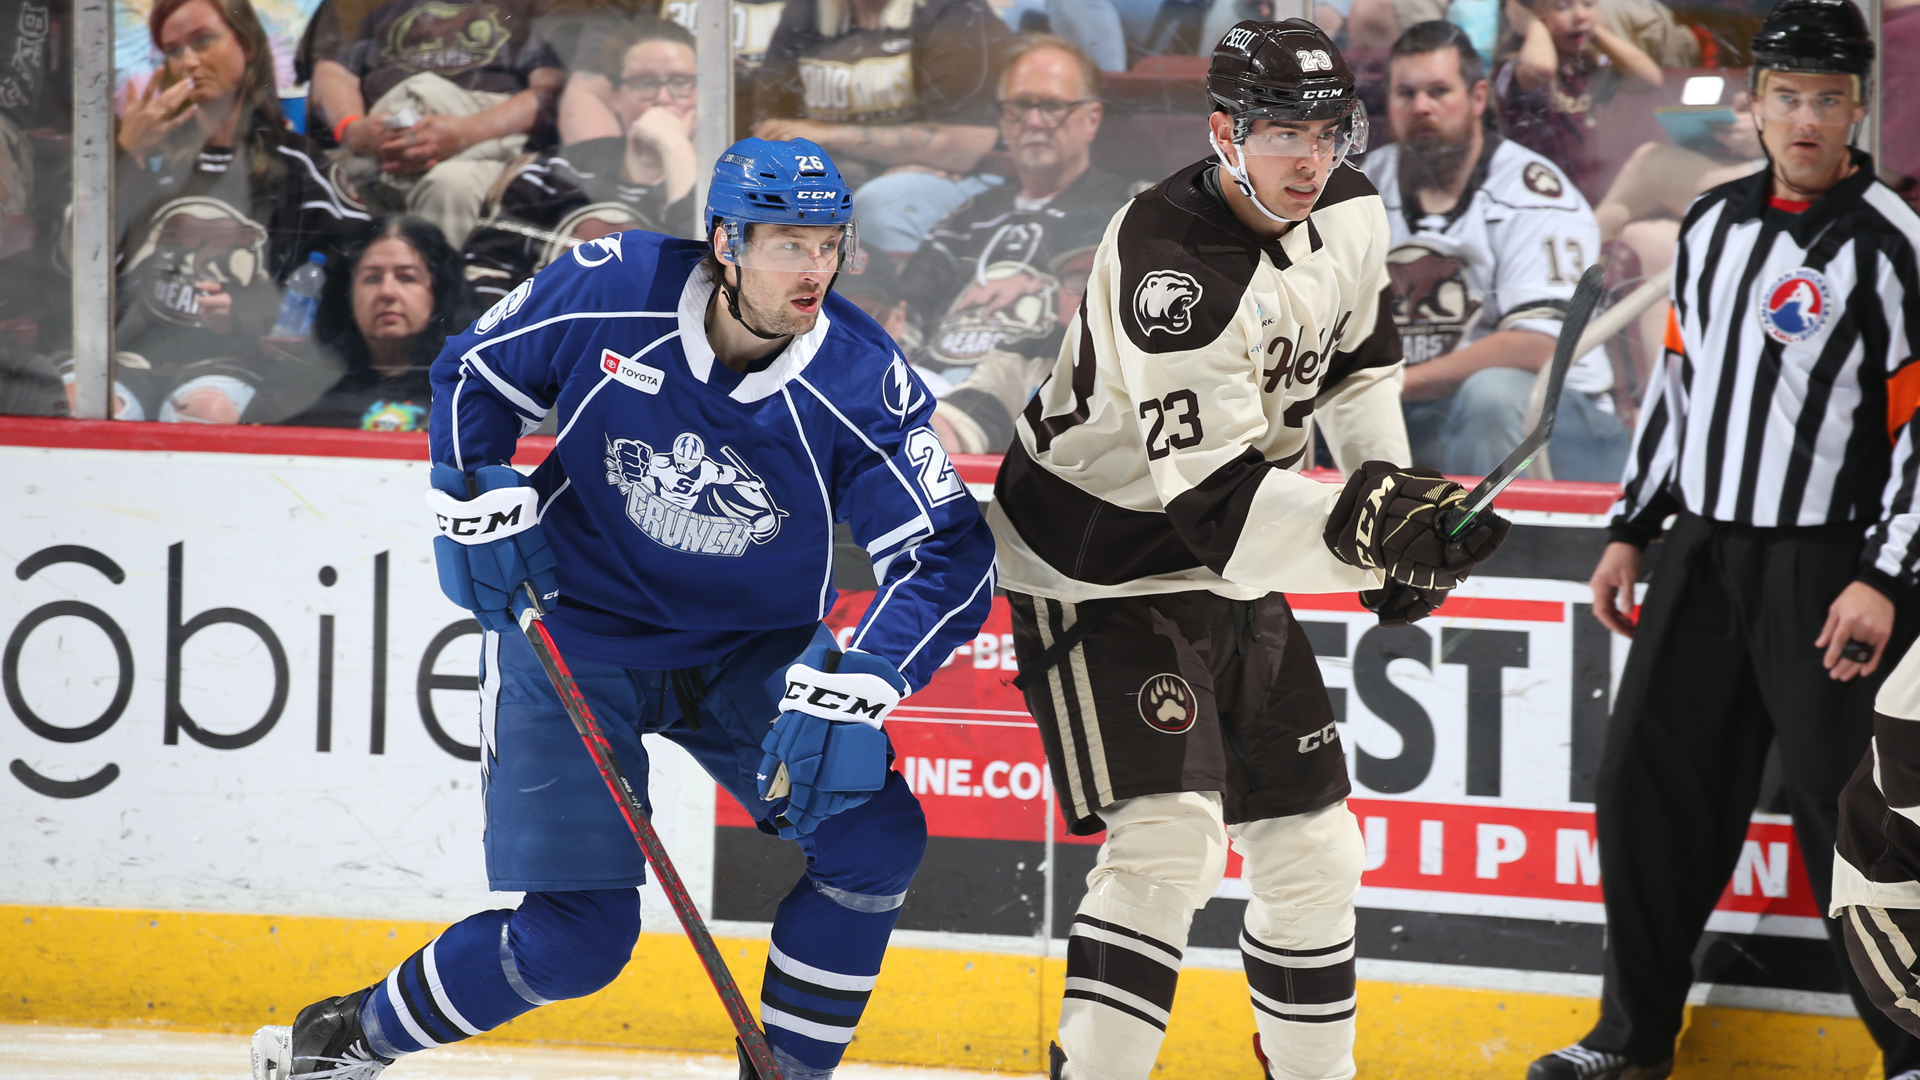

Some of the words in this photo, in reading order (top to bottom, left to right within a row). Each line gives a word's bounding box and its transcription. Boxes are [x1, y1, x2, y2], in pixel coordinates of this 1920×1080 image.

[1222, 28, 1259, 50] PSECU
[1296, 49, 1333, 72] 23
[1302, 88, 1344, 99] CCM
[795, 156, 825, 172] 26
[797, 191, 837, 199] CCM
[1541, 236, 1583, 287] 13
[621, 366, 658, 386] TOYOTA
[1139, 388, 1204, 462] 23
[673, 477, 697, 495] S
[437, 503, 522, 536] CCM
[627, 484, 751, 556] CRUNCH
[1356, 475, 1396, 568] CCM
[785, 681, 886, 719] CCM
